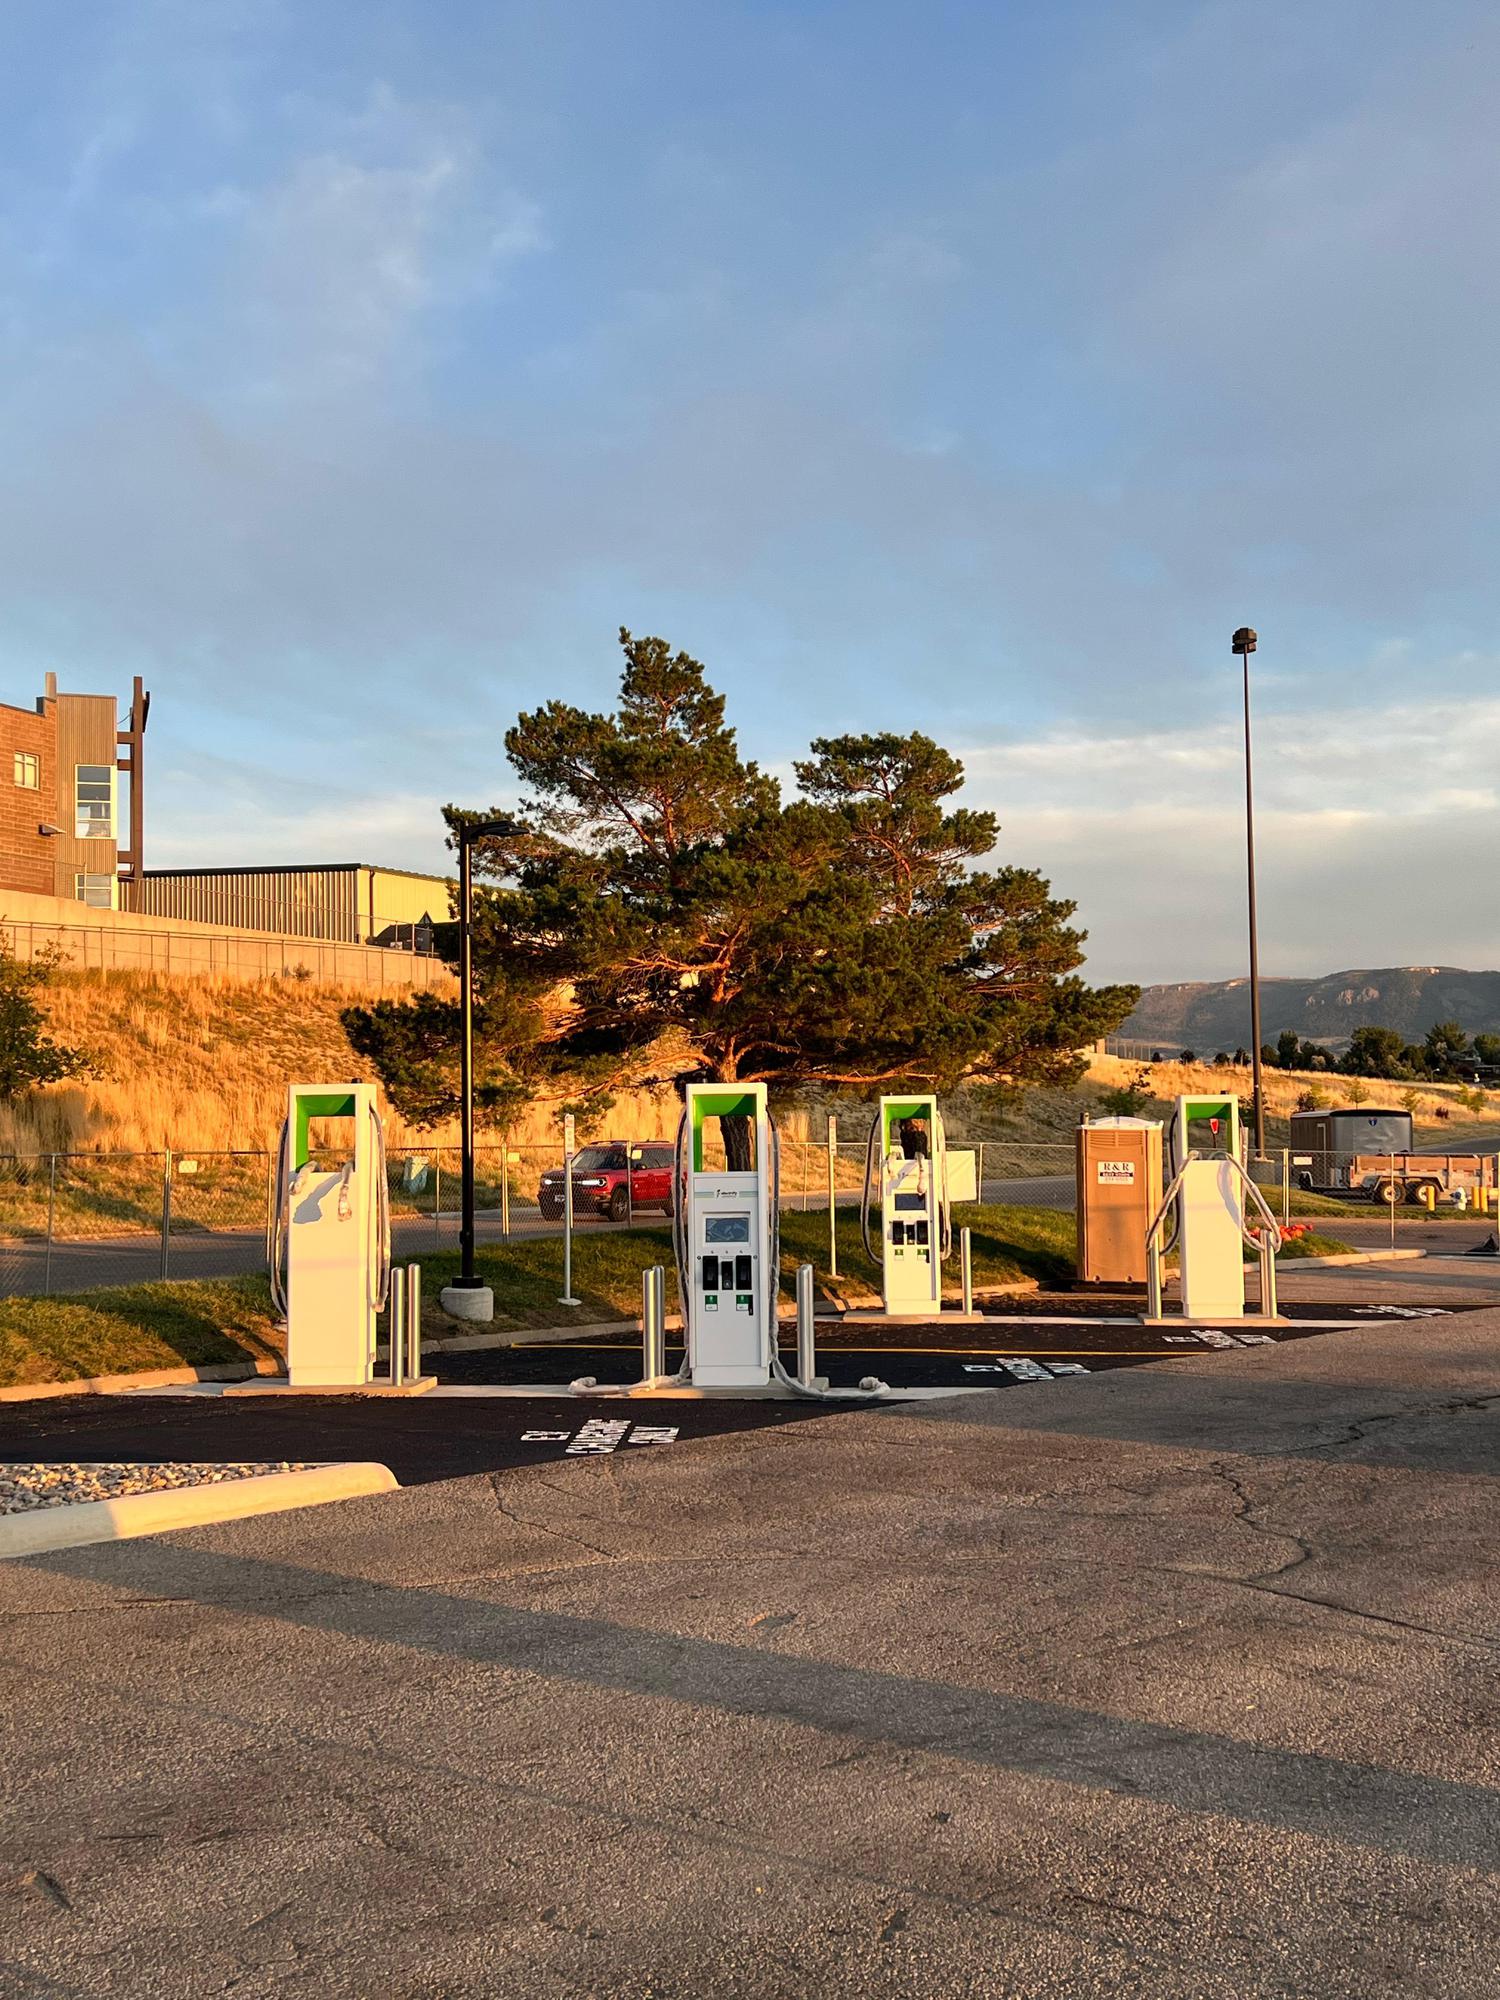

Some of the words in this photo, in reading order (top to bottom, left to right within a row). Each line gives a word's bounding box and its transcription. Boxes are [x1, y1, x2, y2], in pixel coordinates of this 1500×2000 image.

[1104, 1163, 1111, 1171] R
[1112, 1163, 1120, 1171] &
[1122, 1163, 1130, 1171] R
